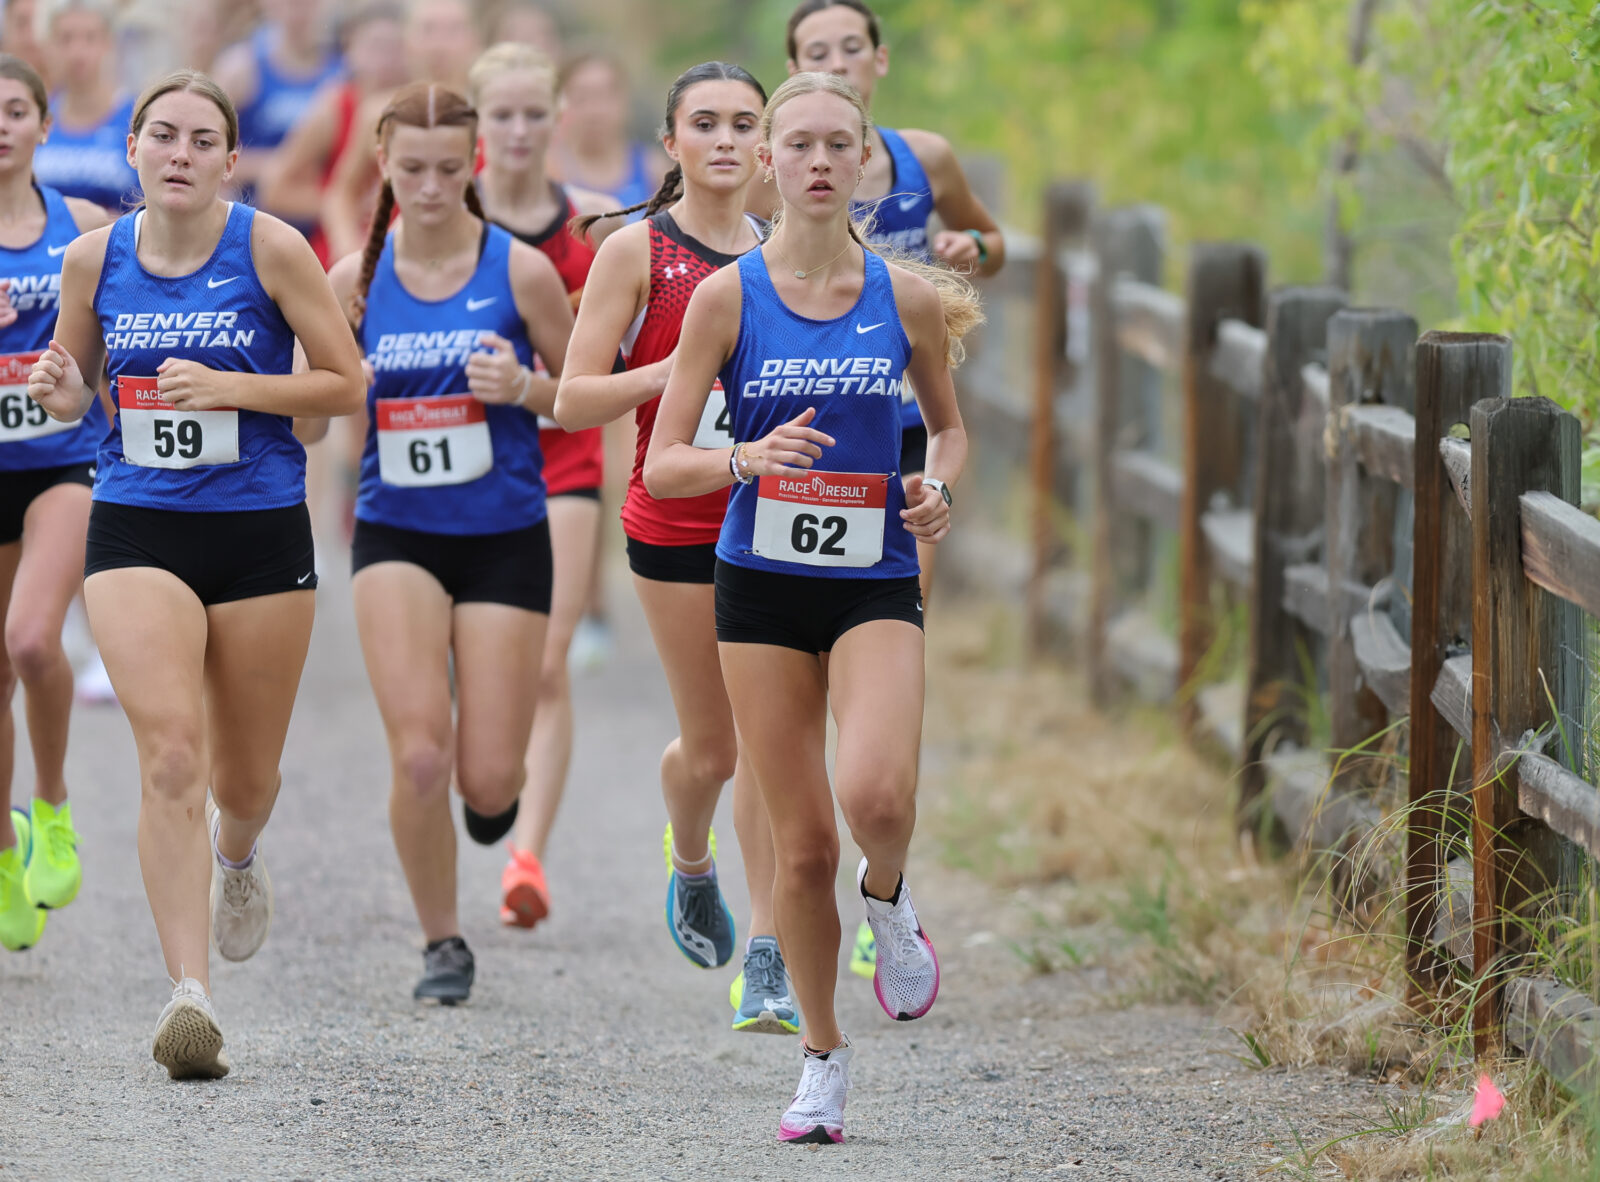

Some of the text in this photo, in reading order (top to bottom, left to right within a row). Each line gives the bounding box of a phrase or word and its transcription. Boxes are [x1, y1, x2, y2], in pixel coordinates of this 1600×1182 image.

[114, 311, 239, 331] DENVER
[105, 329, 256, 350] CHRISTIAN
[759, 357, 892, 378] DENVER
[135, 389, 164, 401] RACE
[742, 376, 902, 398] CHRISTIAN
[0, 394, 48, 429] 65
[714, 404, 735, 438] 4
[153, 419, 203, 459] 59
[408, 437, 452, 474] 61
[779, 480, 868, 498] RACE RESULT
[791, 513, 848, 556] 62
